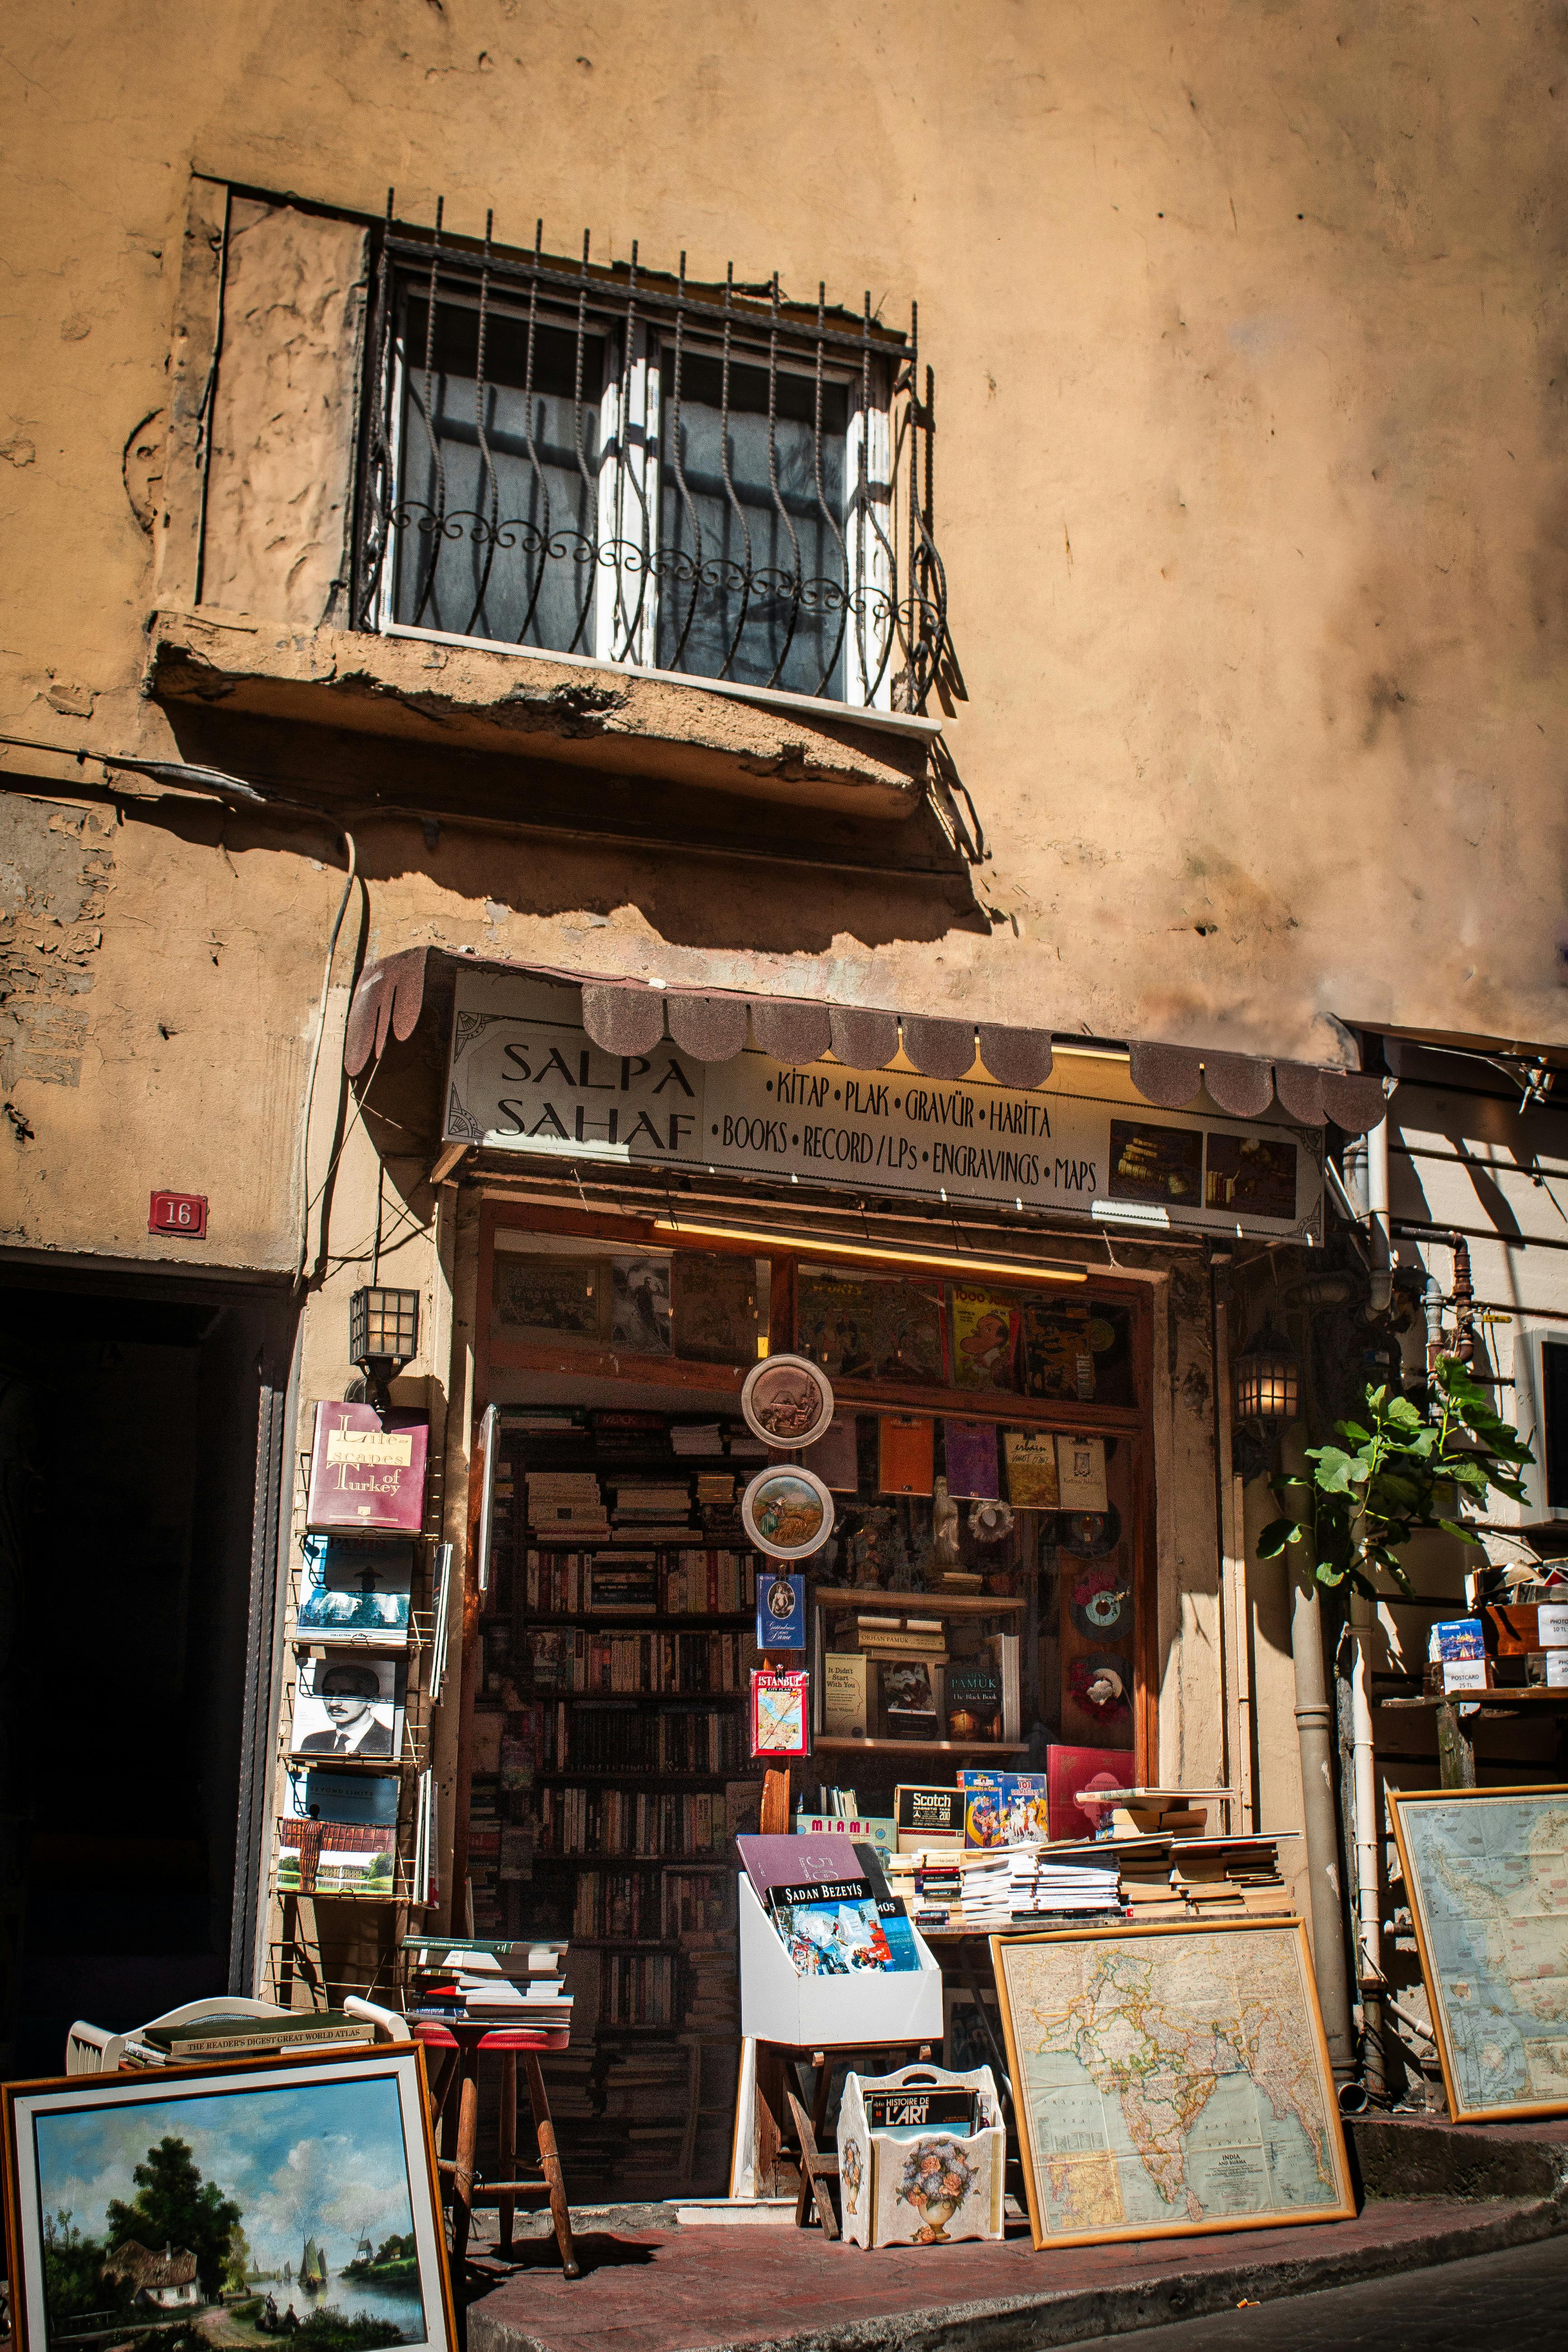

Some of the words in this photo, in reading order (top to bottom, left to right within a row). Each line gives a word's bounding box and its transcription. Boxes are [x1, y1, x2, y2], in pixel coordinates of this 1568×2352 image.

[501, 1044, 696, 1098] SALPA
[777, 1068, 829, 1107] KİTAP
[845, 1080, 889, 1116] PLAK
[905, 1089, 974, 1127] GRAVÜR
[990, 1099, 1051, 1137] HARİTA
[495, 1099, 696, 1150] SAHAF
[722, 1115, 787, 1153] BOOKS
[933, 1142, 1039, 1185] ENGRAVINGS
[1054, 1158, 1097, 1192] MAPS
[166, 1202, 191, 1225] 16
[333, 1451, 403, 1467] scapes
[326, 1462, 402, 1496] Turkey
[382, 1468, 402, 1484] of
[330, 1537, 386, 1551] PARIS
[758, 1676, 803, 1687] ISTANBUL
[951, 1679, 997, 1688] PAMUK
[310, 1786, 343, 1794] BEYOND
[913, 1793, 951, 1808] Scotch
[939, 1811, 951, 1821] 200
[812, 1819, 870, 1834] MIAMI
[785, 1888, 819, 1903] ŞADAN
[821, 1883, 862, 1898] BEZEYİŞ
[187, 2043, 205, 2051] THE
[206, 2039, 246, 2049] READER'S
[247, 2036, 276, 2046] DIGEST
[277, 2034, 304, 2043] GREAT
[306, 2031, 334, 2040] WORLD
[334, 2029, 361, 2038] ATLAS
[886, 2097, 917, 2107] HISTOIRE
[920, 2097, 929, 2105] DE
[886, 2104, 929, 2126] L'ART
